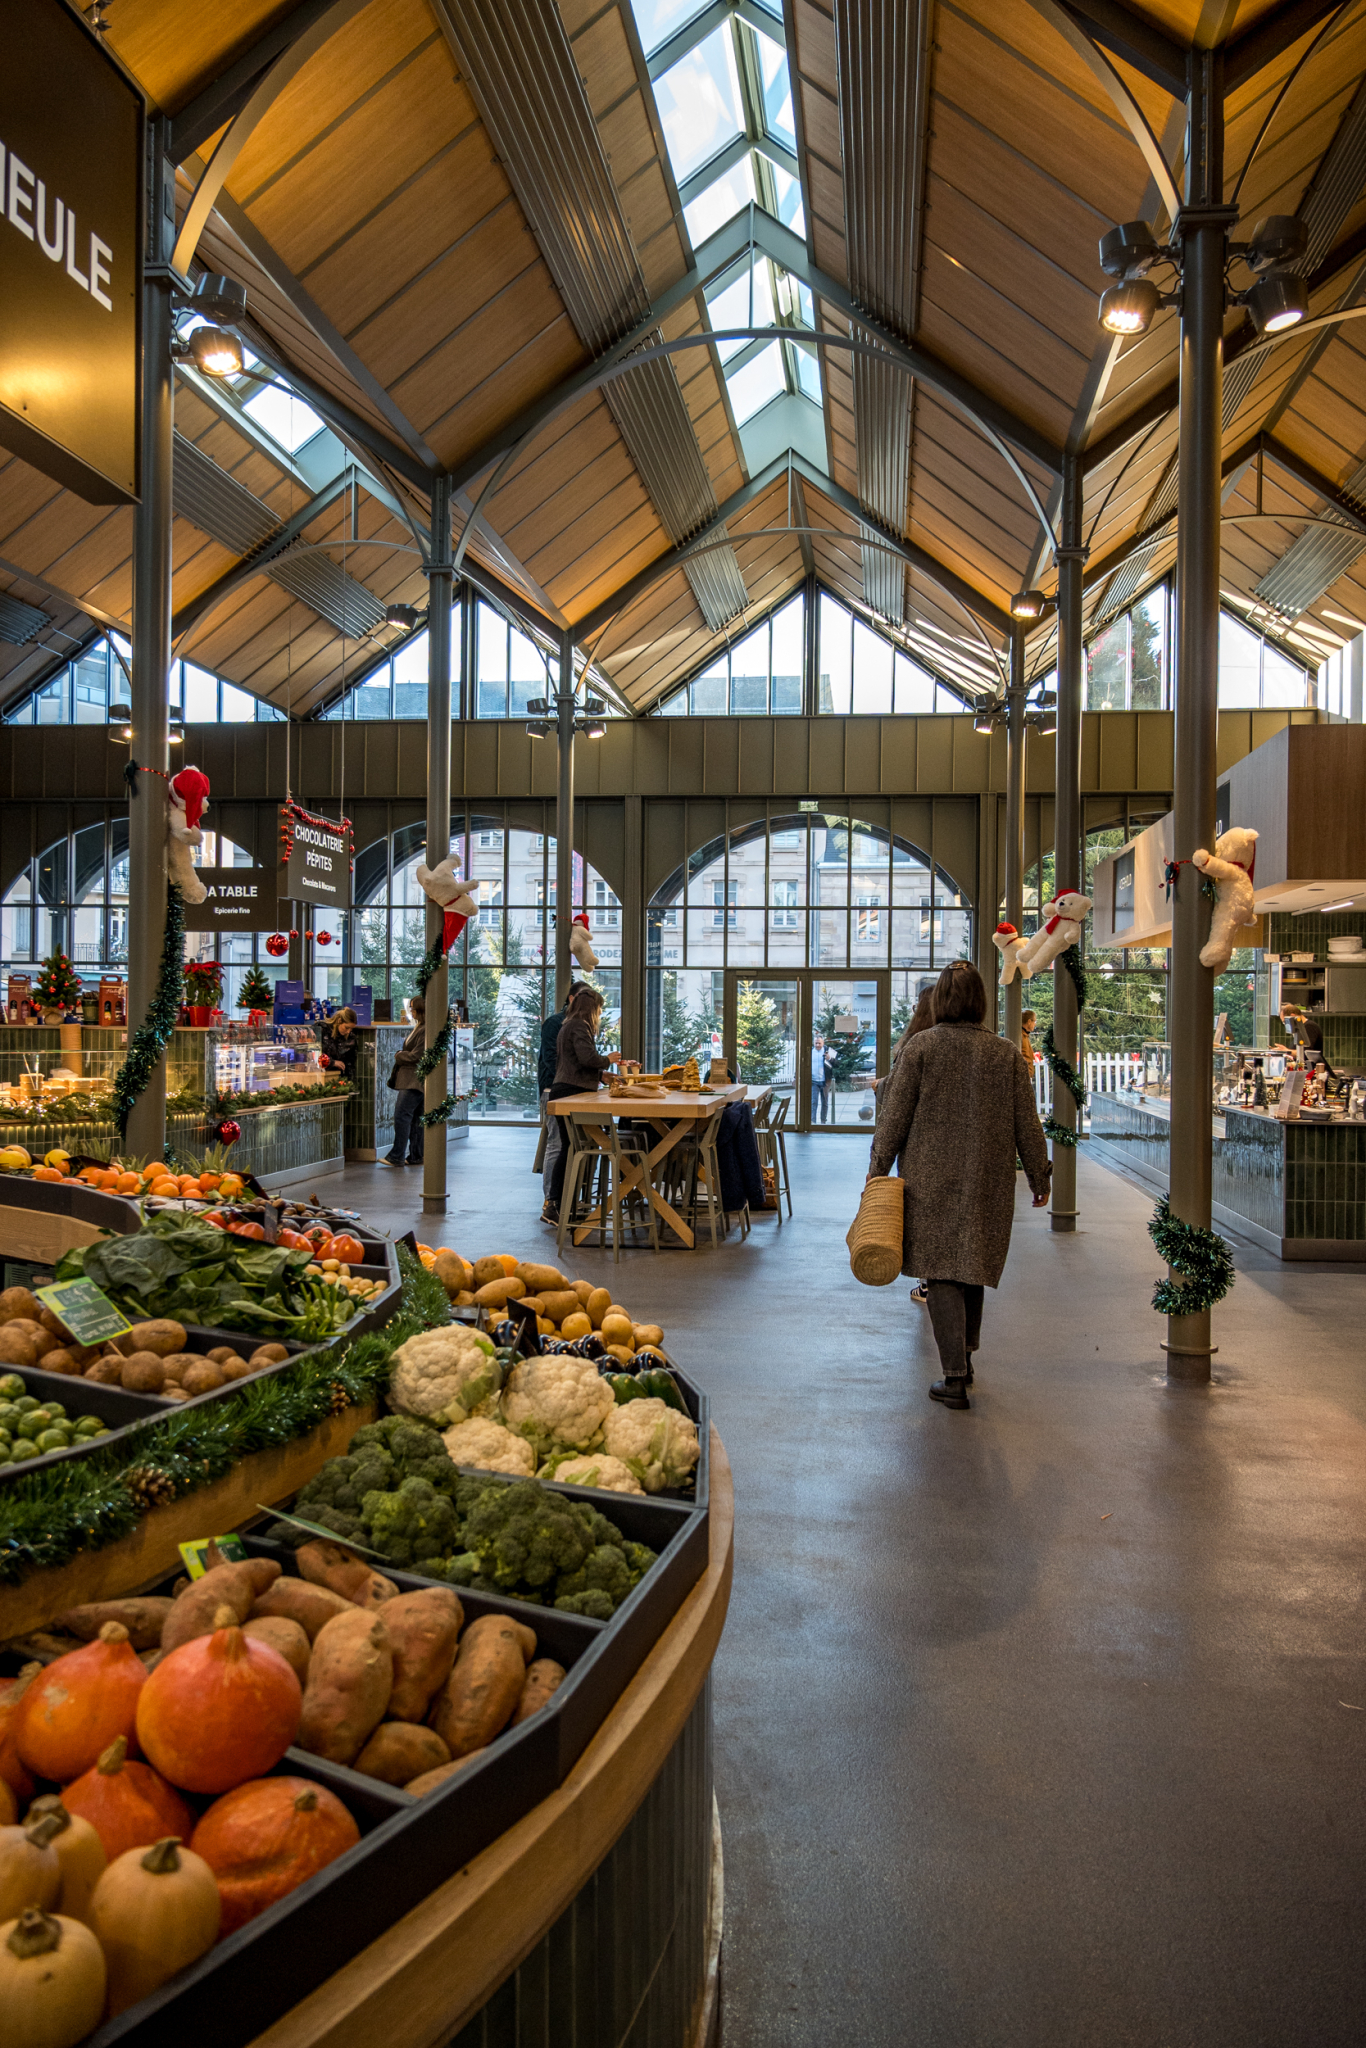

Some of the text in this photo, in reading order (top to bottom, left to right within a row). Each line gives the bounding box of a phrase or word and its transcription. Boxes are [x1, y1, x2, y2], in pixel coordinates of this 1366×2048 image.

[295, 825, 344, 853] CHOCOLATERIE
[306, 848, 333, 872] PÉPITES
[219, 886, 258, 897] TABLE
[214, 907, 238, 915] Epicerie
